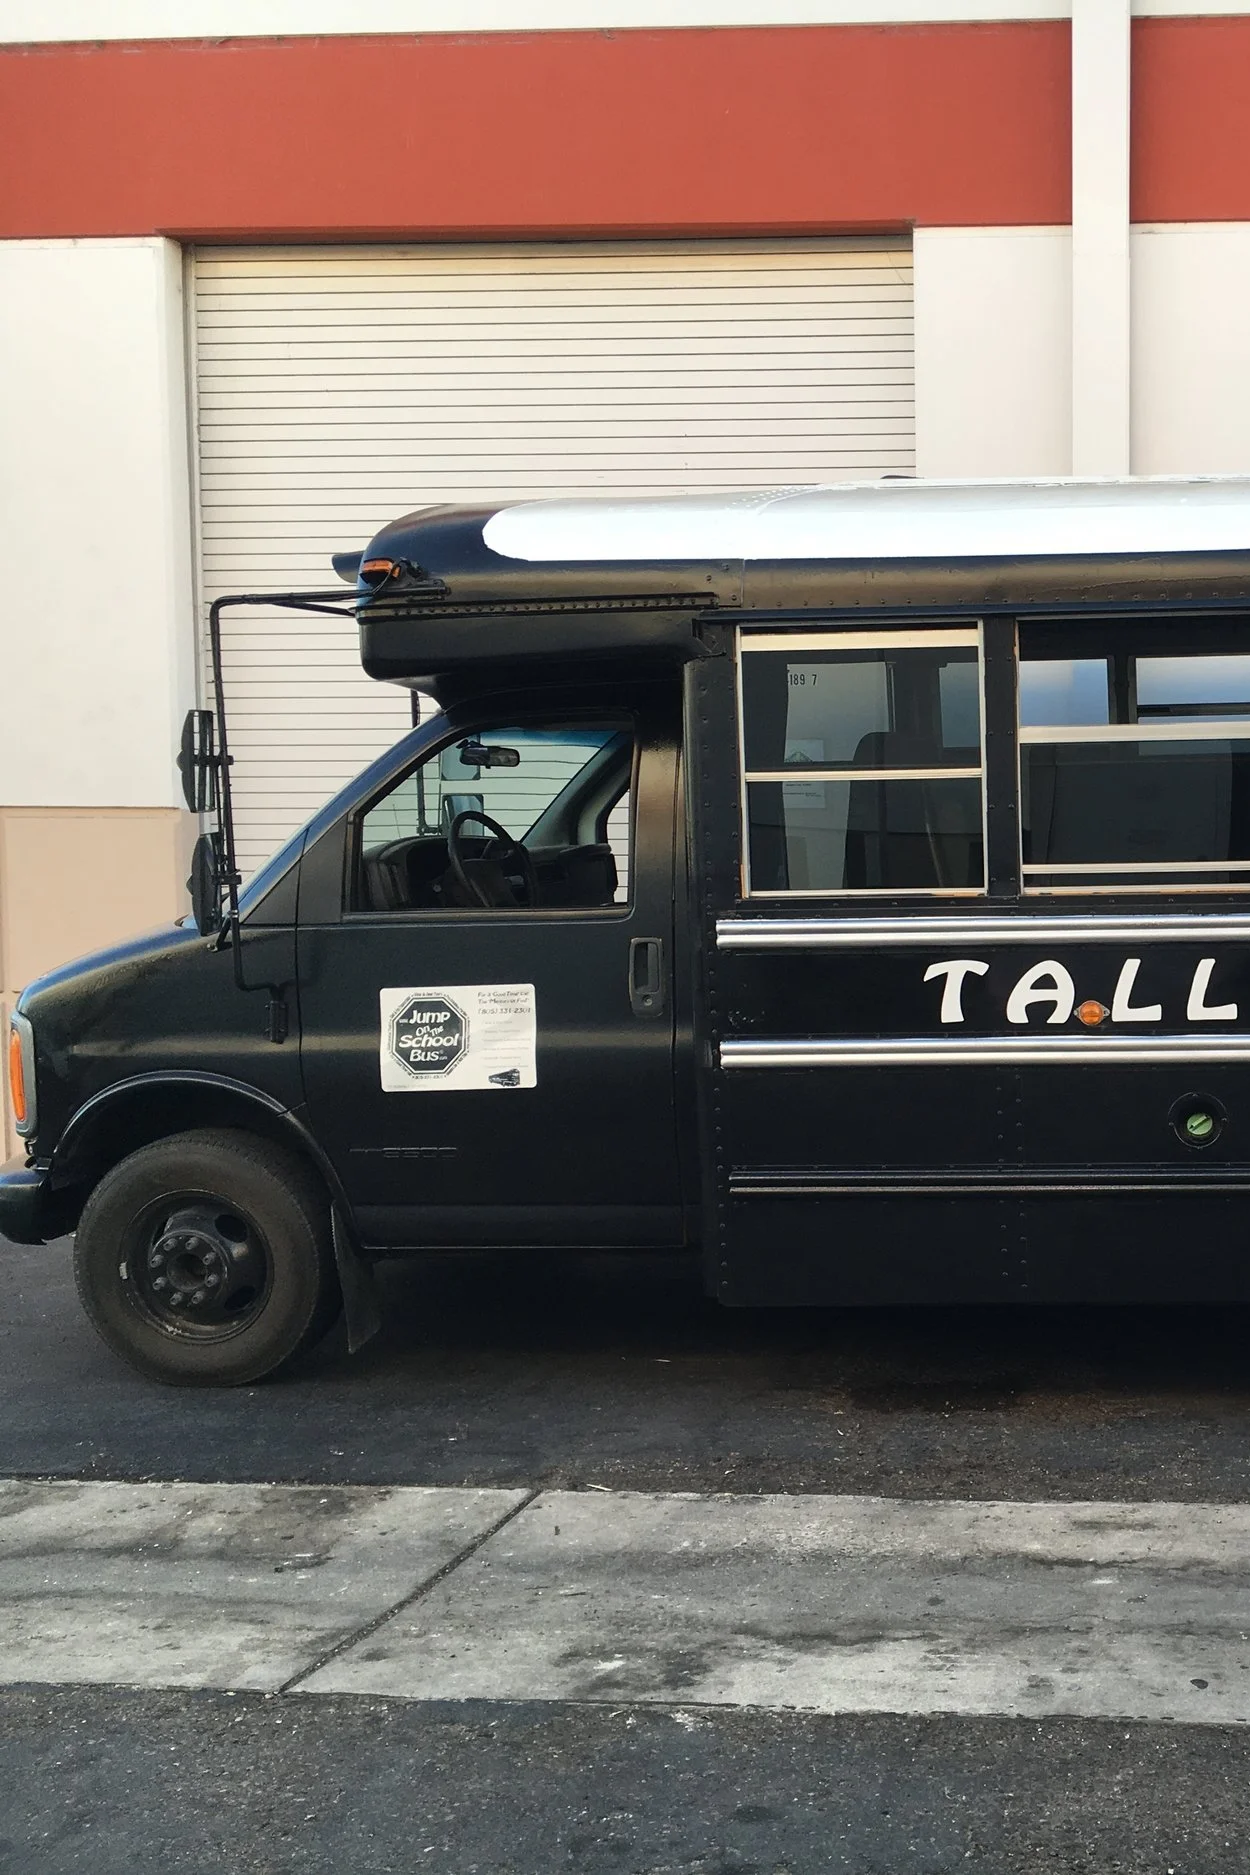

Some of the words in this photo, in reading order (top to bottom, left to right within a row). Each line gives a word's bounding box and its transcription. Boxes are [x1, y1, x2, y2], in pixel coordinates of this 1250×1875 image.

[409, 1009, 451, 1024] Jump
[415, 1025, 431, 1036] On
[429, 1025, 444, 1037] The
[398, 1033, 460, 1048] School
